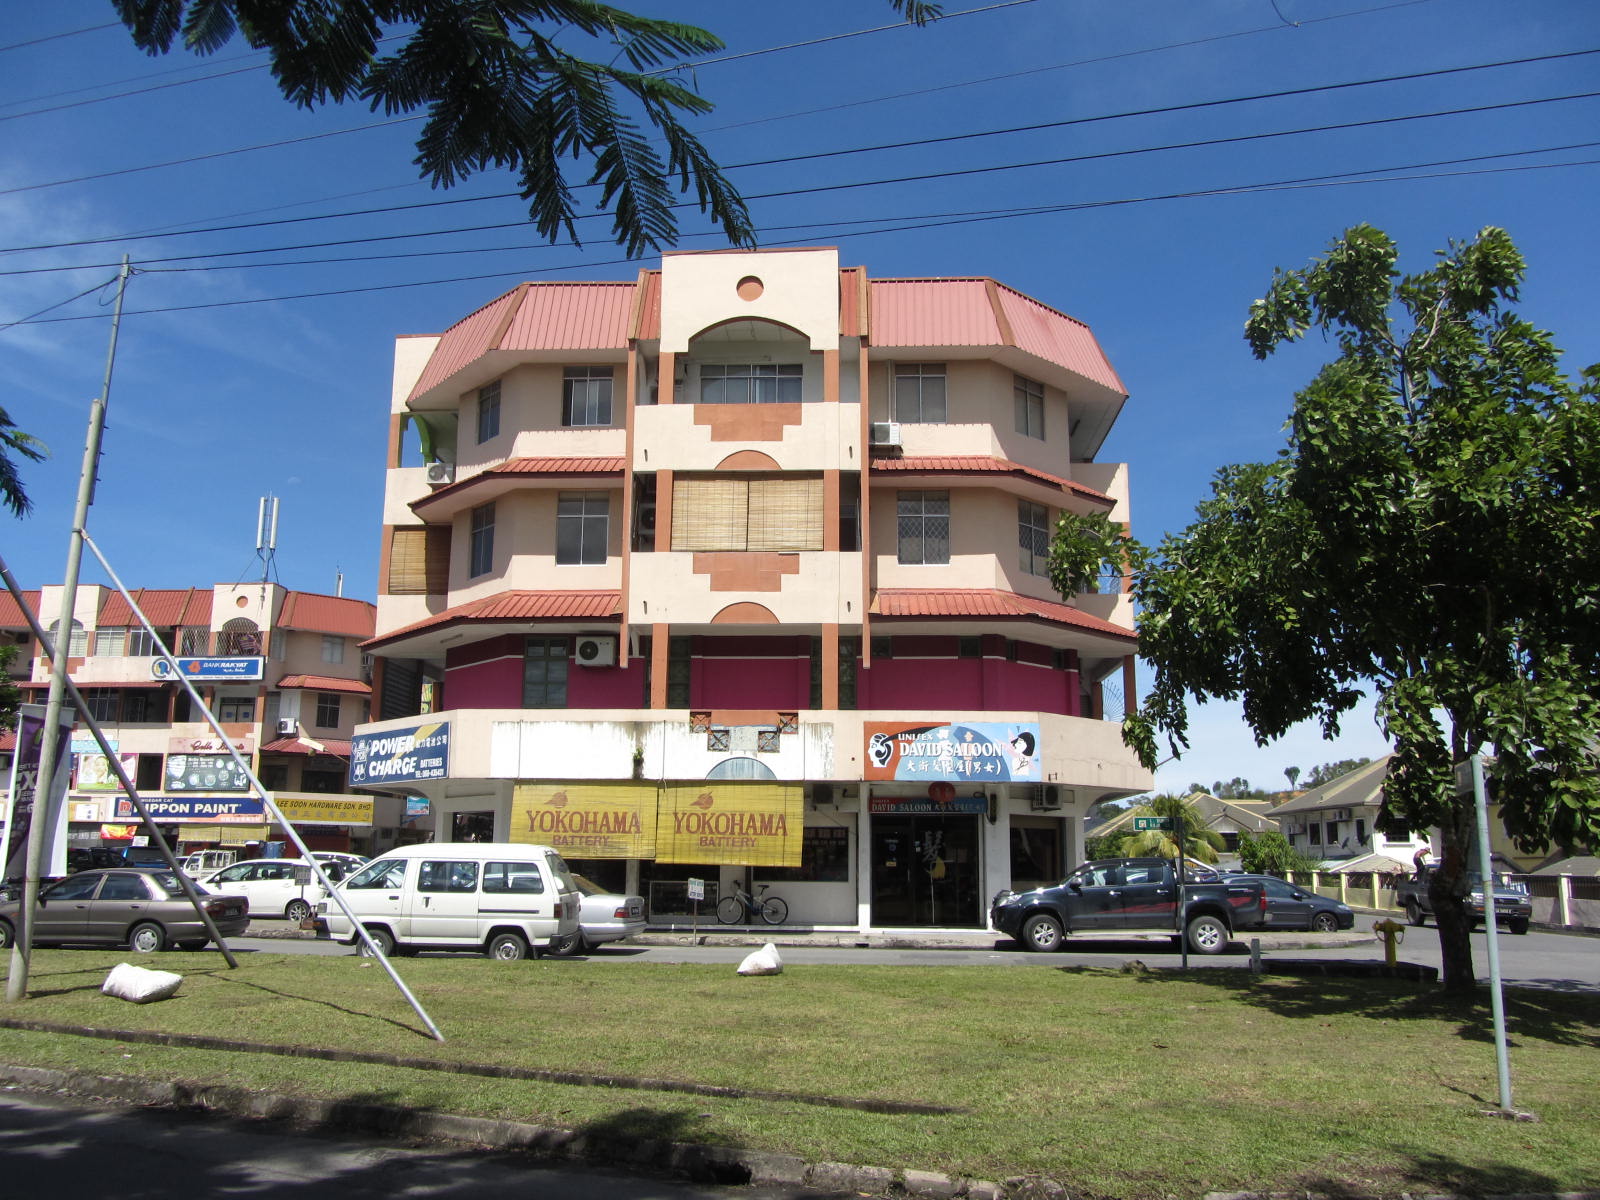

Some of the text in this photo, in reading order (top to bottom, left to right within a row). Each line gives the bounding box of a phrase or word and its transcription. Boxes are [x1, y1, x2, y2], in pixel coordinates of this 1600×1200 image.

[898, 733, 934, 741] UNISEX
[370, 735, 416, 757] POWER
[899, 742, 1003, 758] DAVID SALOON
[369, 757, 418, 777] CHARGE
[420, 757, 442, 768] BATTERIES
[194, 803, 237, 814] PAINT
[309, 801, 341, 809] HARDWARE
[871, 803, 896, 812] DAVID
[900, 803, 932, 812] SALOON
[526, 810, 642, 834] YOKOHAMA
[672, 812, 788, 836] YOKOHAMA
[552, 835, 610, 846] BATTERY
[699, 836, 757, 847] BATTERY
